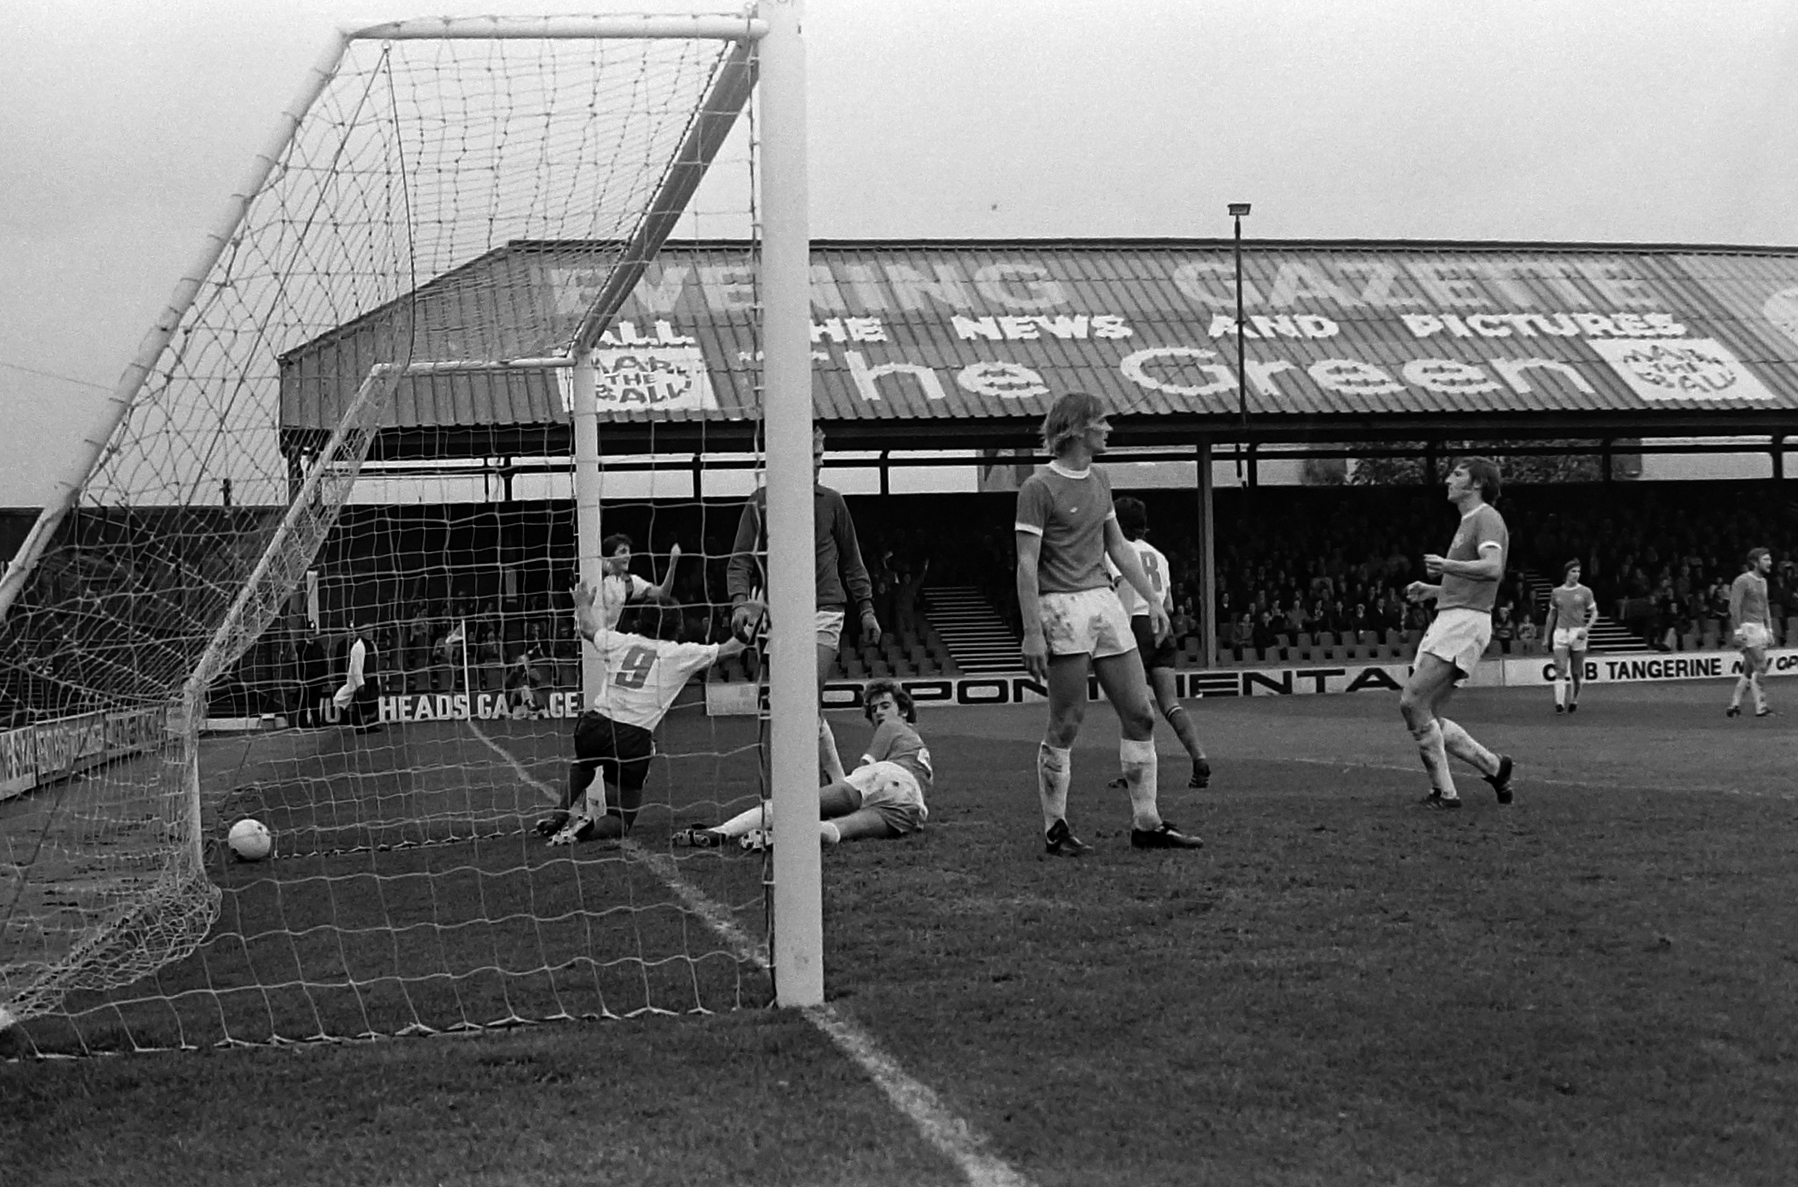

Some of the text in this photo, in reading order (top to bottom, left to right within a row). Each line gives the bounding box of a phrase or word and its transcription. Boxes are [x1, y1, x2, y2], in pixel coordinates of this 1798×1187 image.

[1173, 258, 1662, 309] GAZETTE
[810, 316, 888, 342] HE
[951, 314, 1134, 340] NEWS
[1208, 313, 1340, 338] AND
[1400, 312, 1688, 337] PICTURES
[1120, 345, 1597, 396] Green
[1140, 551, 1162, 592] 8
[615, 645, 657, 689] 9
[1542, 662, 1599, 682] CB
[1605, 658, 1722, 681] TANGERINE
[378, 692, 579, 721] HEADS GAGE
